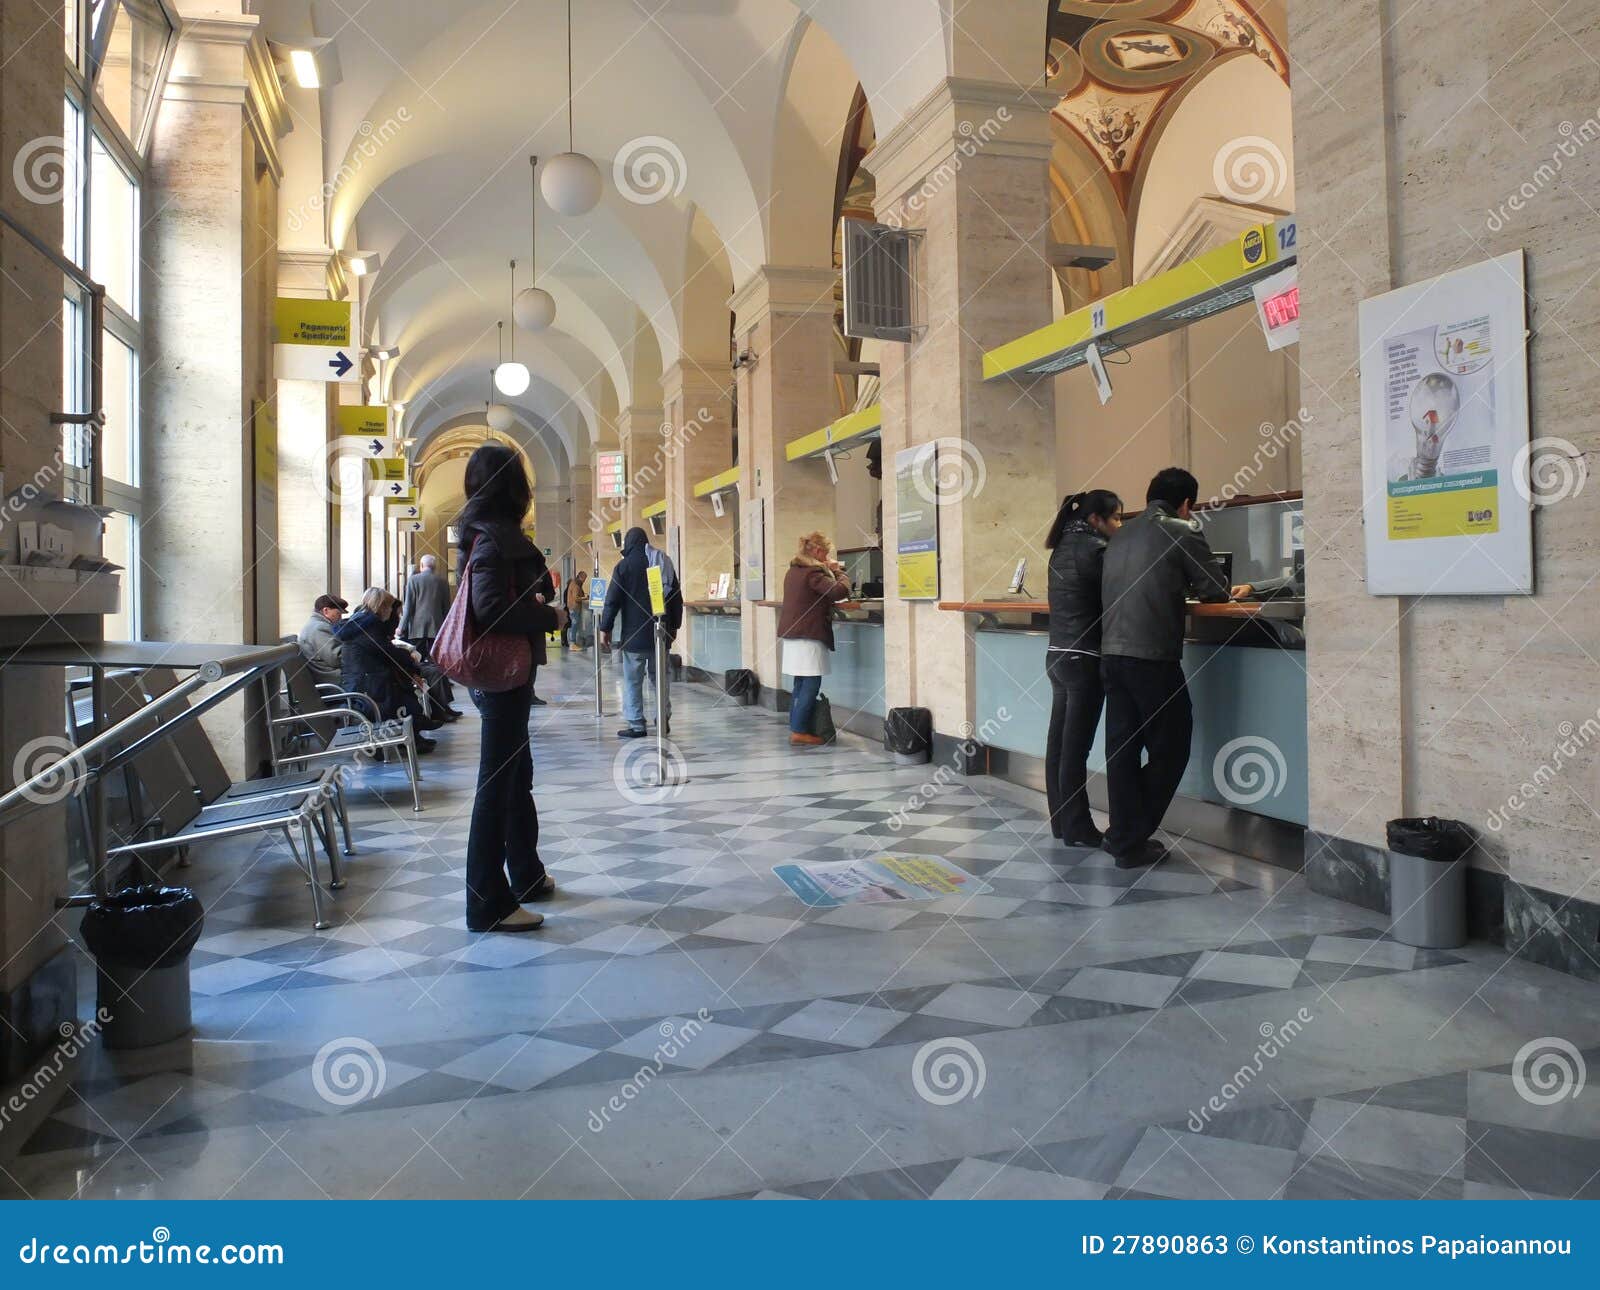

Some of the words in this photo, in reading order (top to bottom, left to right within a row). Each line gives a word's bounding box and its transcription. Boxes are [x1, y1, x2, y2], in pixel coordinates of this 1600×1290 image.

[1279, 224, 1296, 249] 12
[1093, 310, 1103, 329] 11
[300, 322, 346, 332] Pagamenti
[301, 331, 346, 341] Spedizioni
